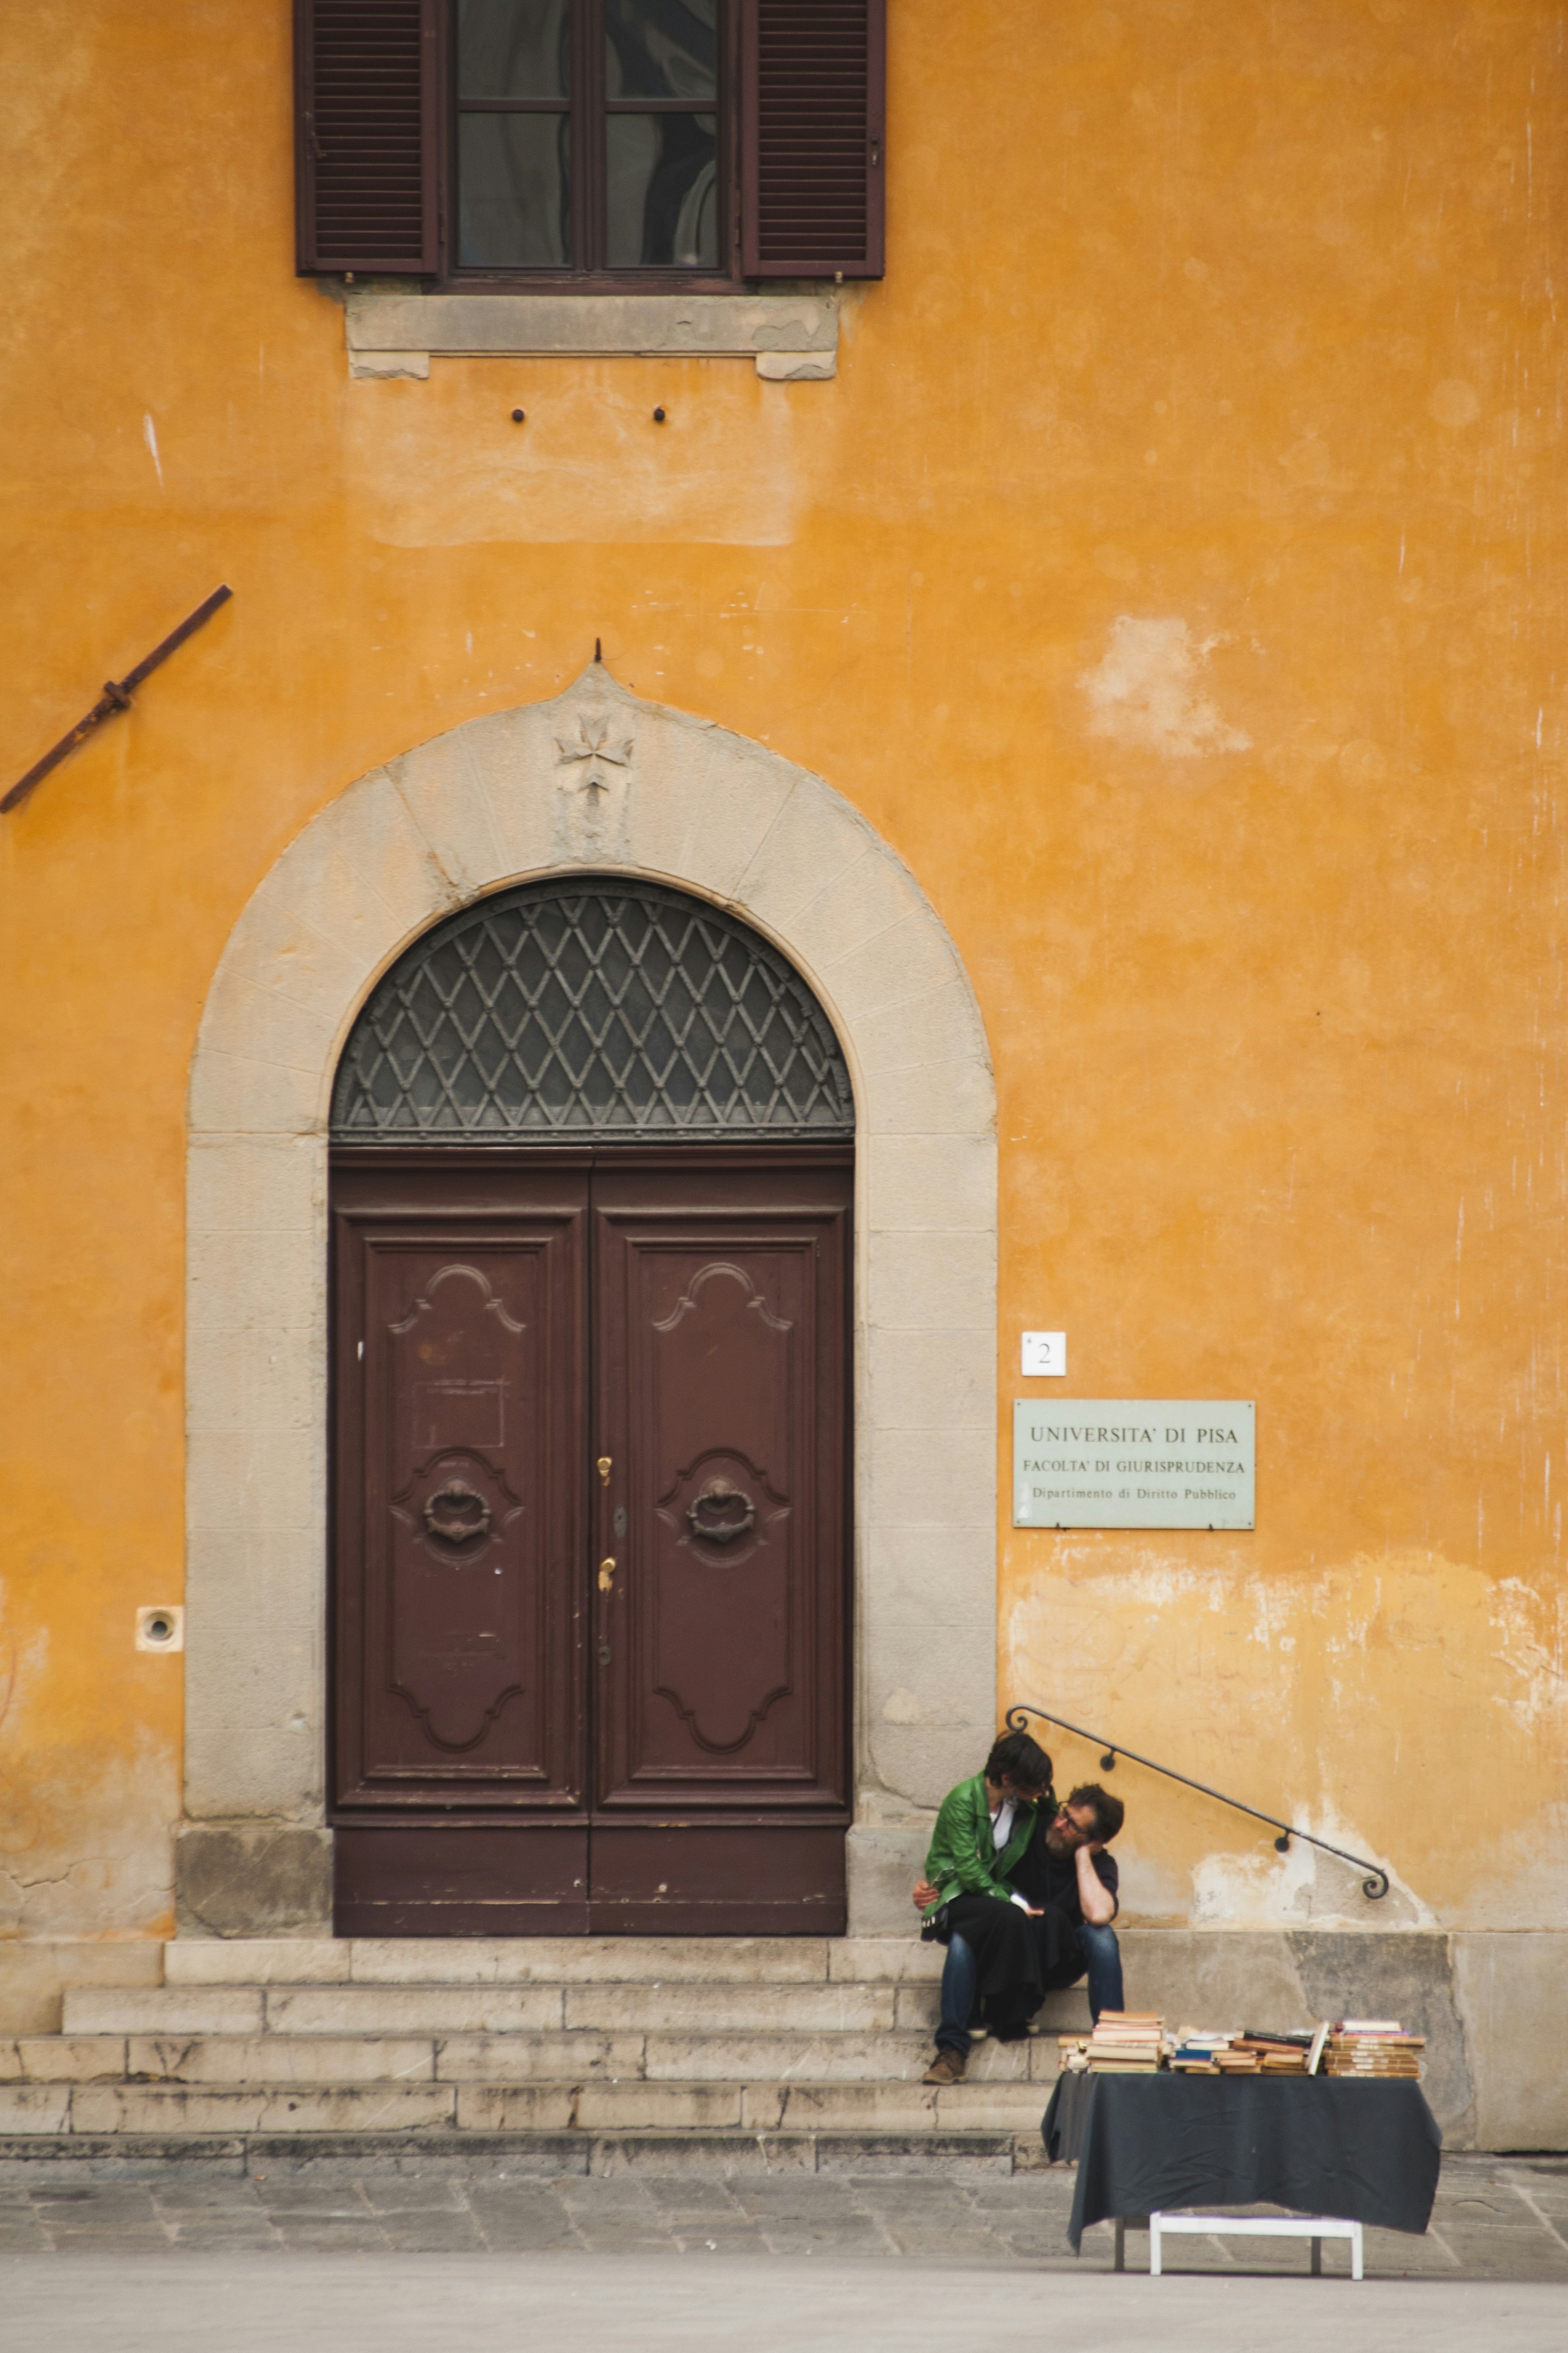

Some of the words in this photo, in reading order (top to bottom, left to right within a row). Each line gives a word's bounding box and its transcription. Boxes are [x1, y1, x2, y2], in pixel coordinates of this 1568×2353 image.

[1039, 1343, 1051, 1363] 2
[1030, 1427, 1157, 1443] UNIVERSITA'
[1165, 1428, 1186, 1443] DI
[1197, 1429, 1239, 1444] PISA
[1023, 1460, 1090, 1472] FACOLTA'
[1094, 1460, 1110, 1473] DI
[1116, 1461, 1245, 1473] GIURISPRUDENZA
[1032, 1487, 1113, 1501] Dipartimento
[1118, 1487, 1130, 1499] di
[1136, 1488, 1178, 1499] Diritto
[1184, 1488, 1236, 1500] Pubblico
